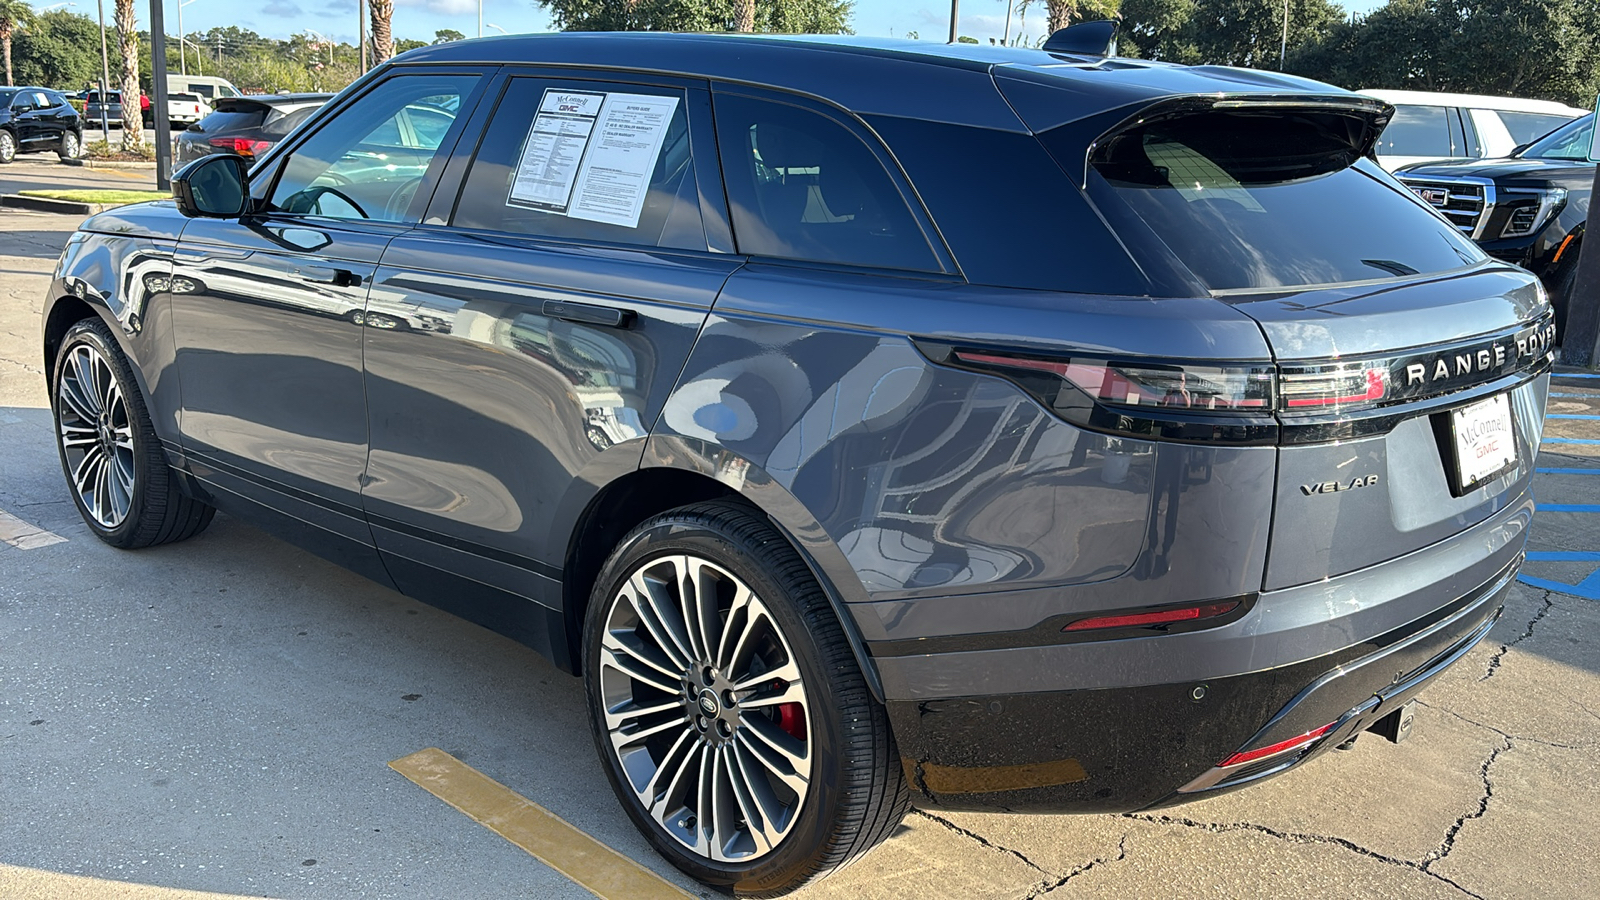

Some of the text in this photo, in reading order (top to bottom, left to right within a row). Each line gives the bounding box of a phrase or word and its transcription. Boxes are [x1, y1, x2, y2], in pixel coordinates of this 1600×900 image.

[557, 95, 589, 106] McConnell
[559, 104, 579, 112] GMC
[1411, 188, 1446, 203] MC
[1406, 345, 1506, 386] RANGE
[1460, 413, 1508, 446] McConnell
[1475, 440, 1500, 459] GMC
[1299, 474, 1379, 497] VELAR
